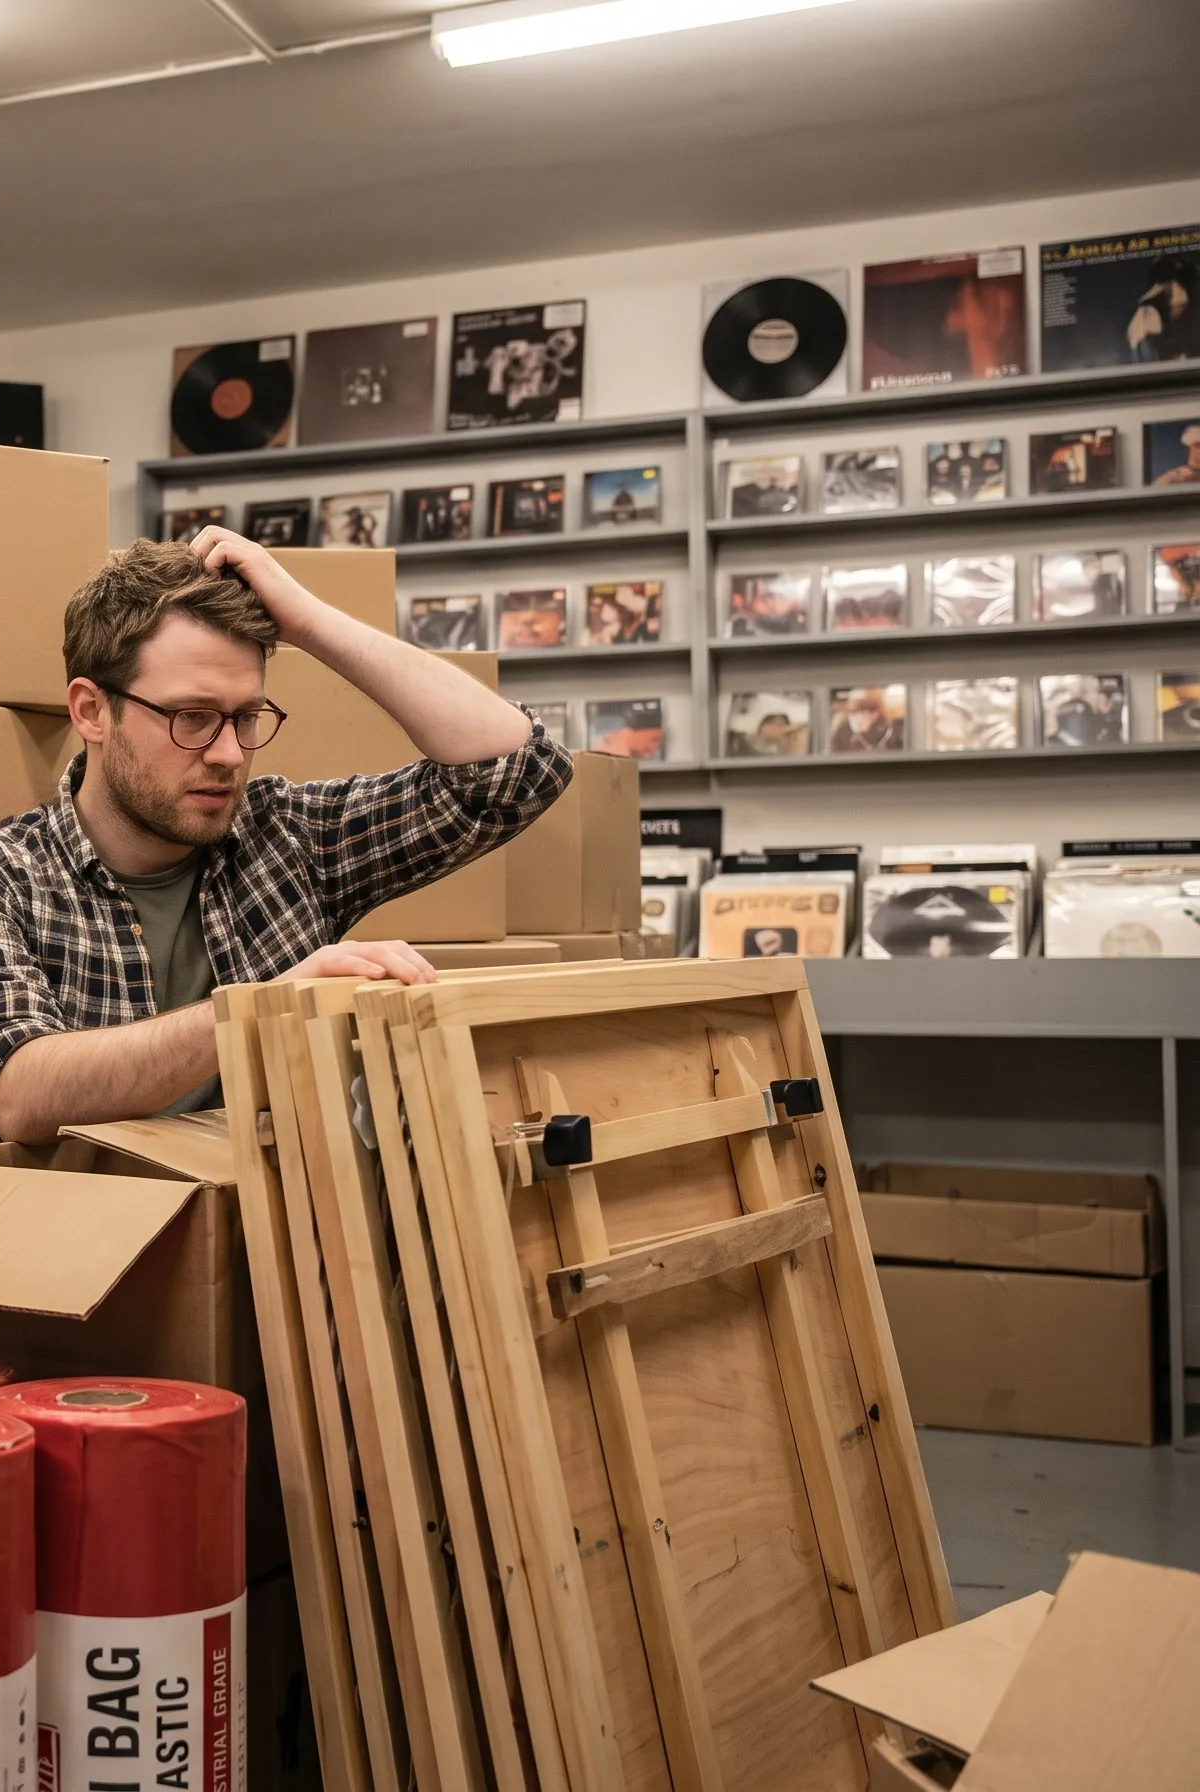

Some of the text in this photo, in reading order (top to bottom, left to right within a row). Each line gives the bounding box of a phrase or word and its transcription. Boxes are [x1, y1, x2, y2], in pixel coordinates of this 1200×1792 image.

[85, 1647, 141, 1758] BAG
[155, 1676, 189, 1789] ASTIC
[212, 1646, 228, 1718] GRADE
